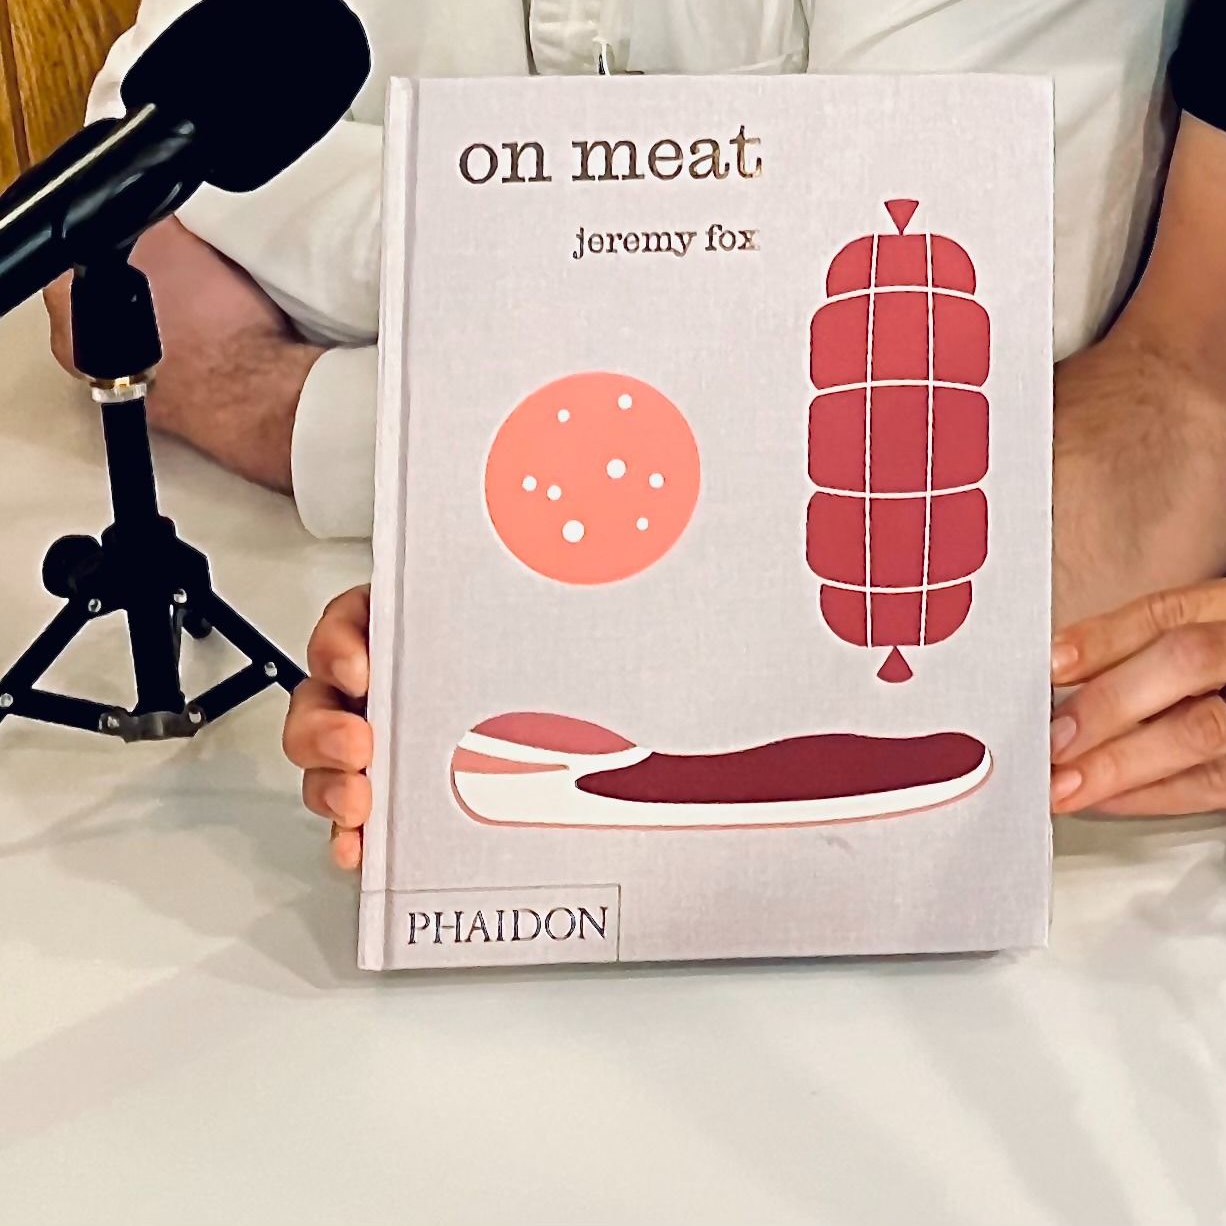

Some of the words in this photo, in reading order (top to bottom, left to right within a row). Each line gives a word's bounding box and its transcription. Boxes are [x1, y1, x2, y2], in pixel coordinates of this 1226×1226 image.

[459, 141, 552, 185] on
[571, 124, 762, 182] meat
[572, 226, 697, 260] jeremy
[704, 223, 759, 253] fox
[407, 905, 608, 946] PHAIDON
